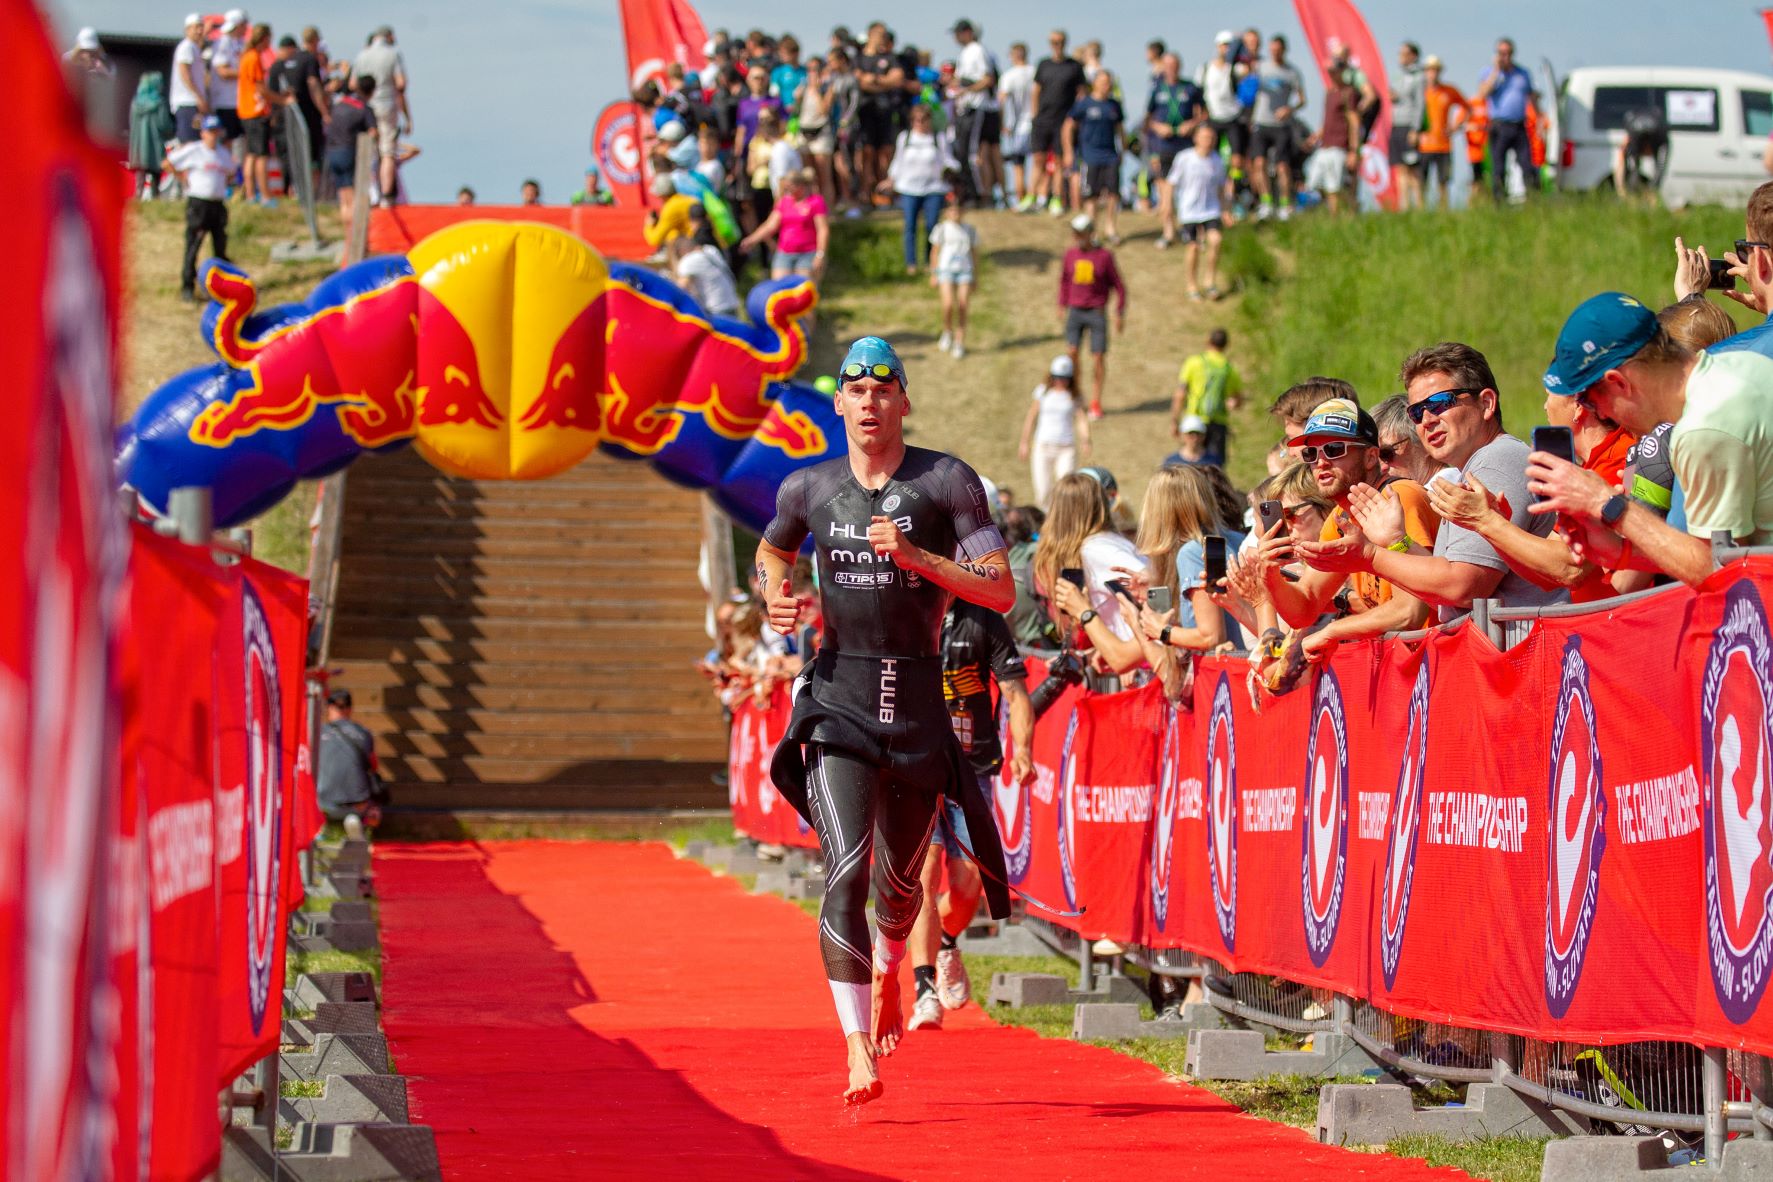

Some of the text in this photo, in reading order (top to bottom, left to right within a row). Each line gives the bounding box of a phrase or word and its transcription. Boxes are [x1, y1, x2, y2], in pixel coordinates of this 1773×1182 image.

[829, 515, 913, 541] HUB
[848, 573, 890, 583] TIPOS
[879, 659, 897, 724] HUUB
[1427, 792, 1444, 845] THE
[1615, 784, 1637, 844] THE
[1562, 868, 1598, 999] SLOVAKIA
